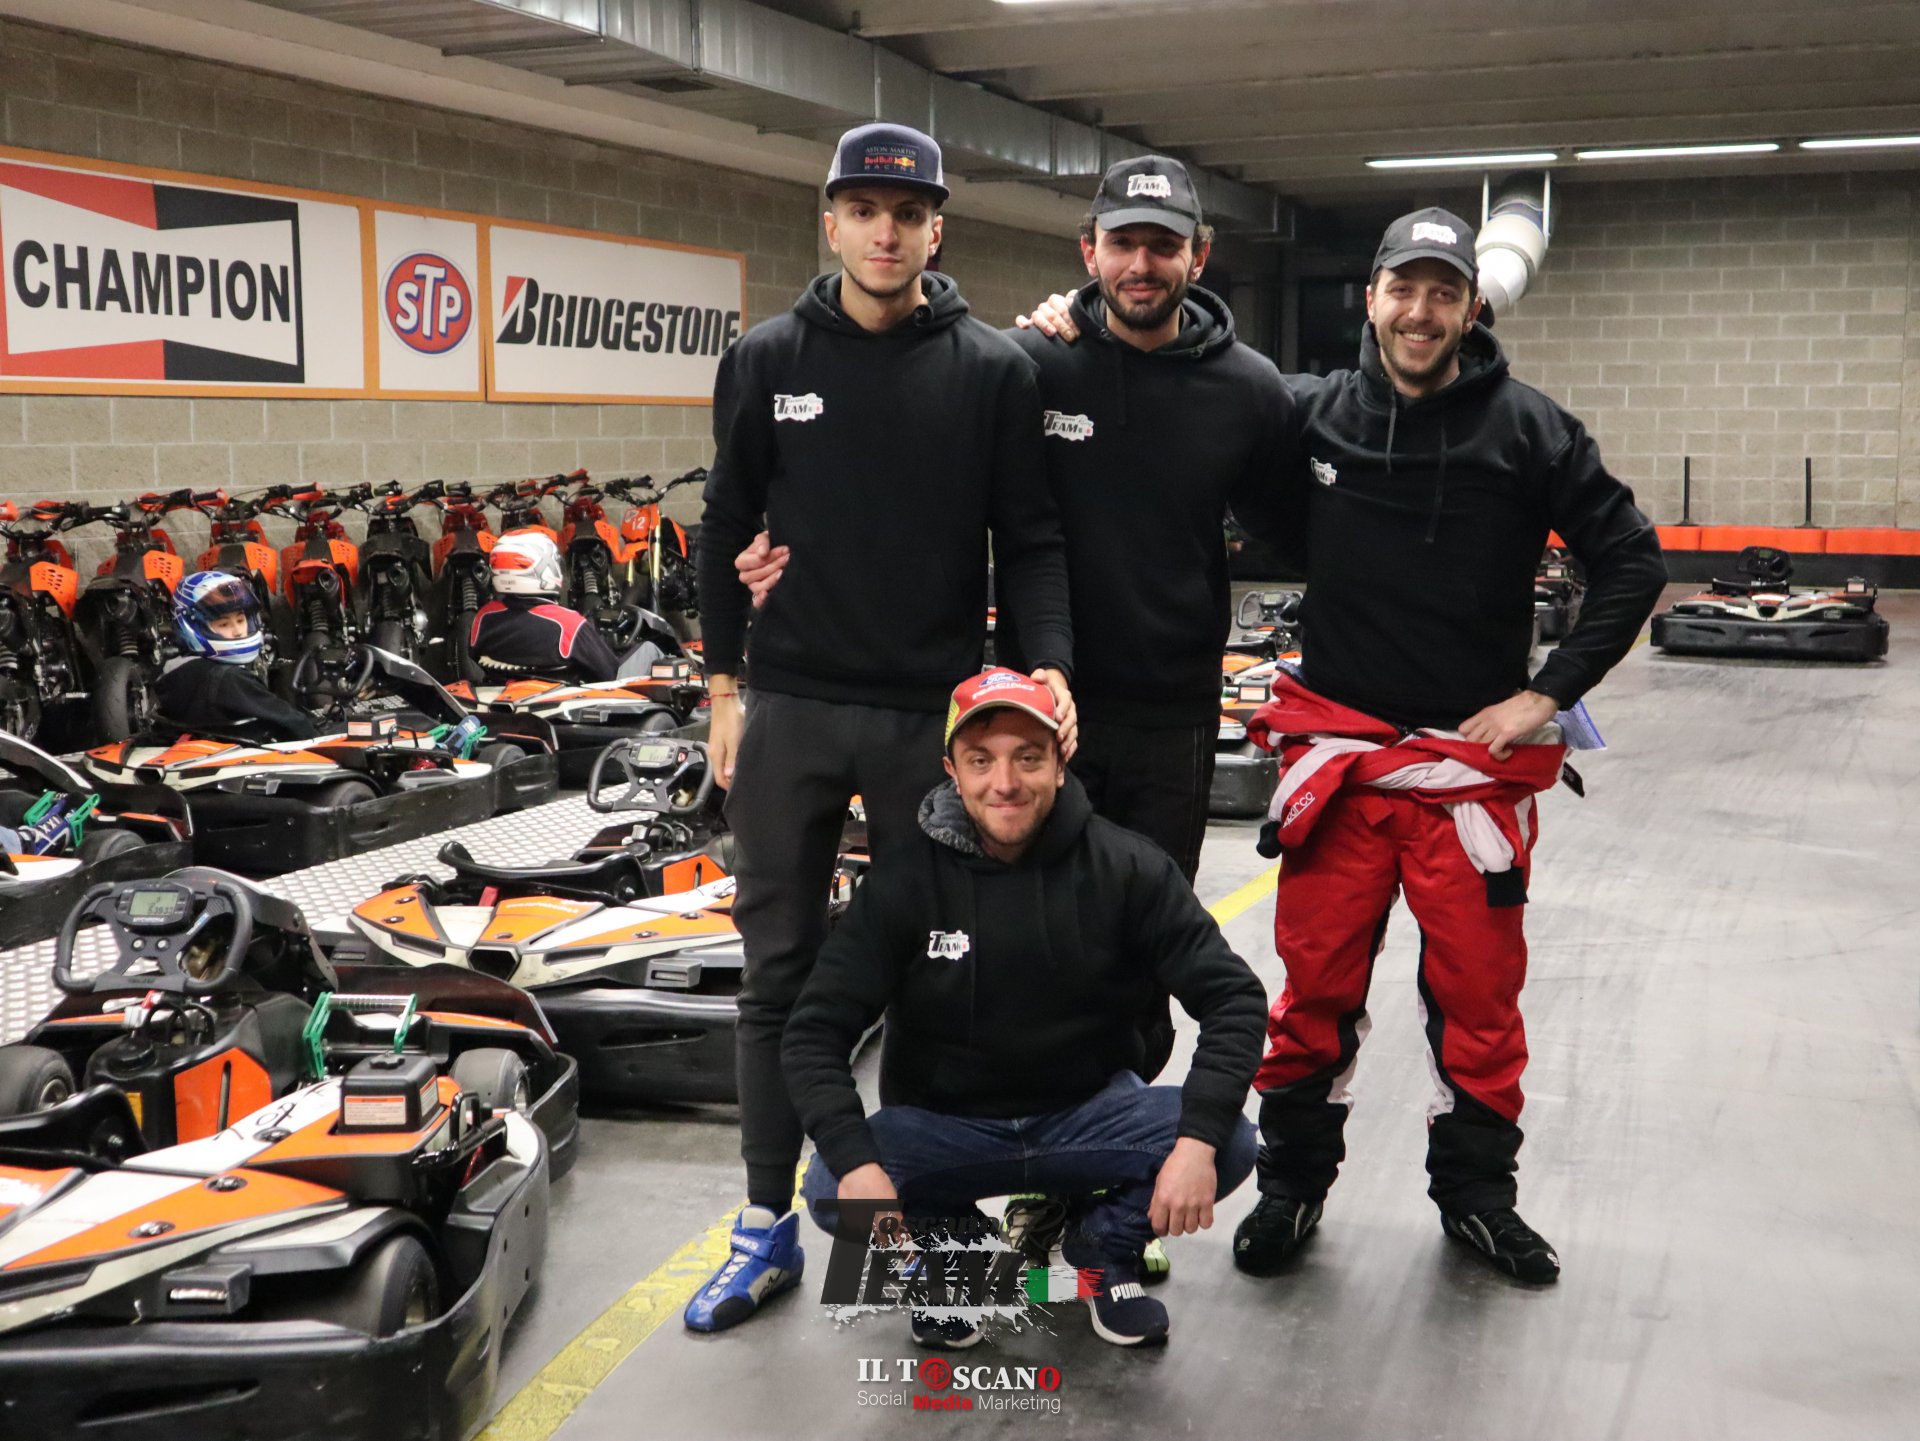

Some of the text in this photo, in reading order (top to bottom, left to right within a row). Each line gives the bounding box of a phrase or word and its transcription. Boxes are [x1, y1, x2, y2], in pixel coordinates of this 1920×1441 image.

[13, 239, 291, 323] CHAMPION
[394, 263, 464, 340] STP
[495, 275, 741, 357] BRIDGESTONE
